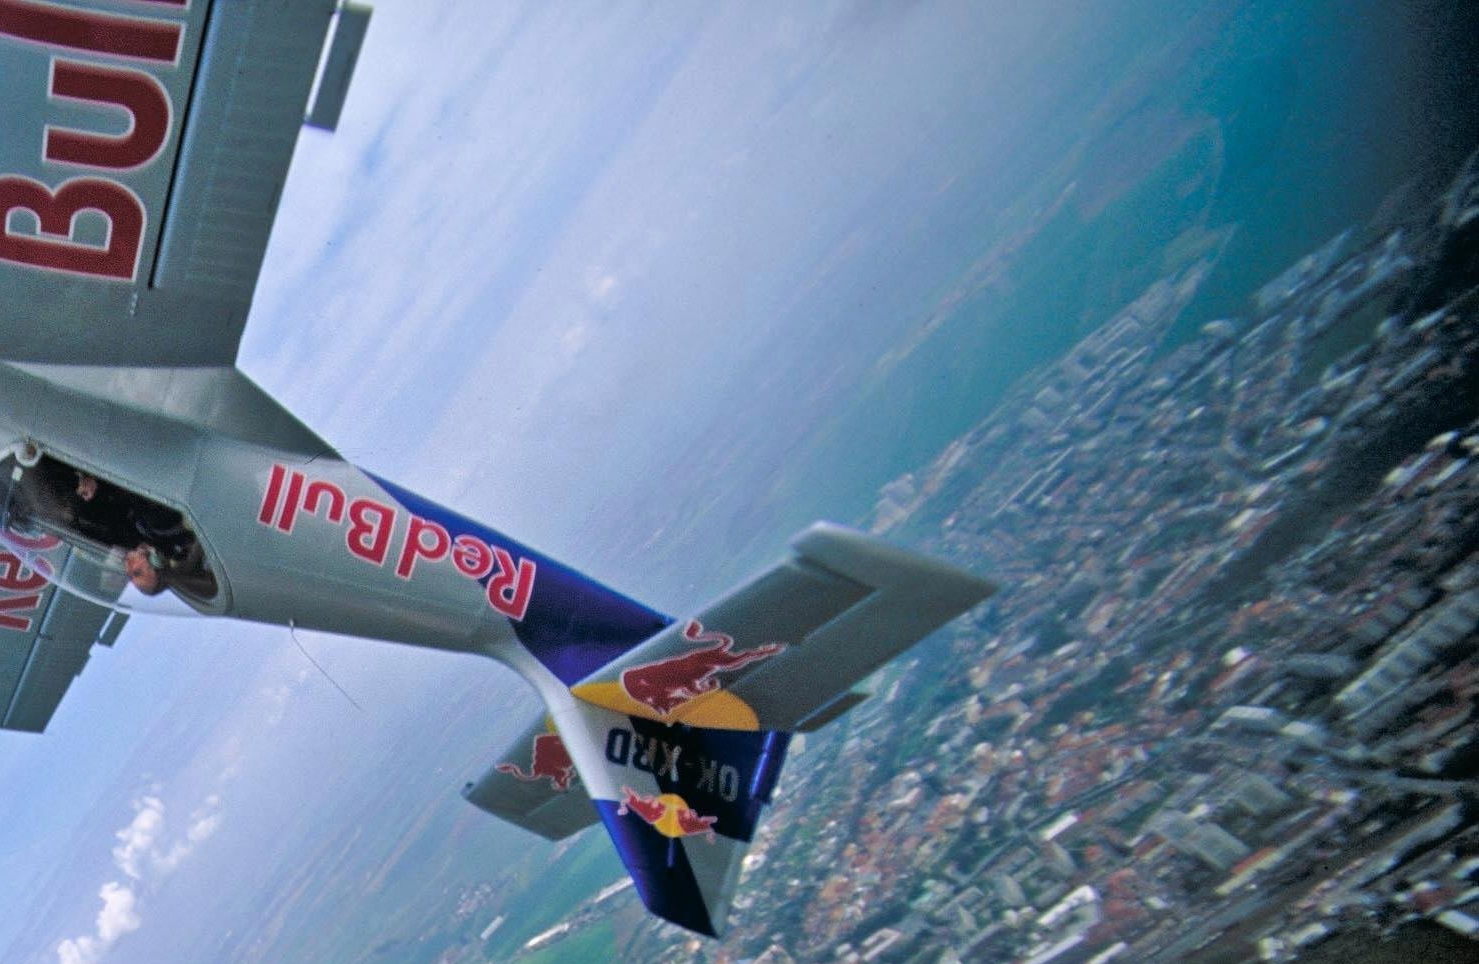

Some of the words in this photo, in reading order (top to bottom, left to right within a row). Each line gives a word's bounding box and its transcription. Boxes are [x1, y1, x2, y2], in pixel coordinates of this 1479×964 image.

[257, 463, 399, 568] Bull
[394, 512, 537, 622] Red
[605, 727, 740, 803] OK-XRD
